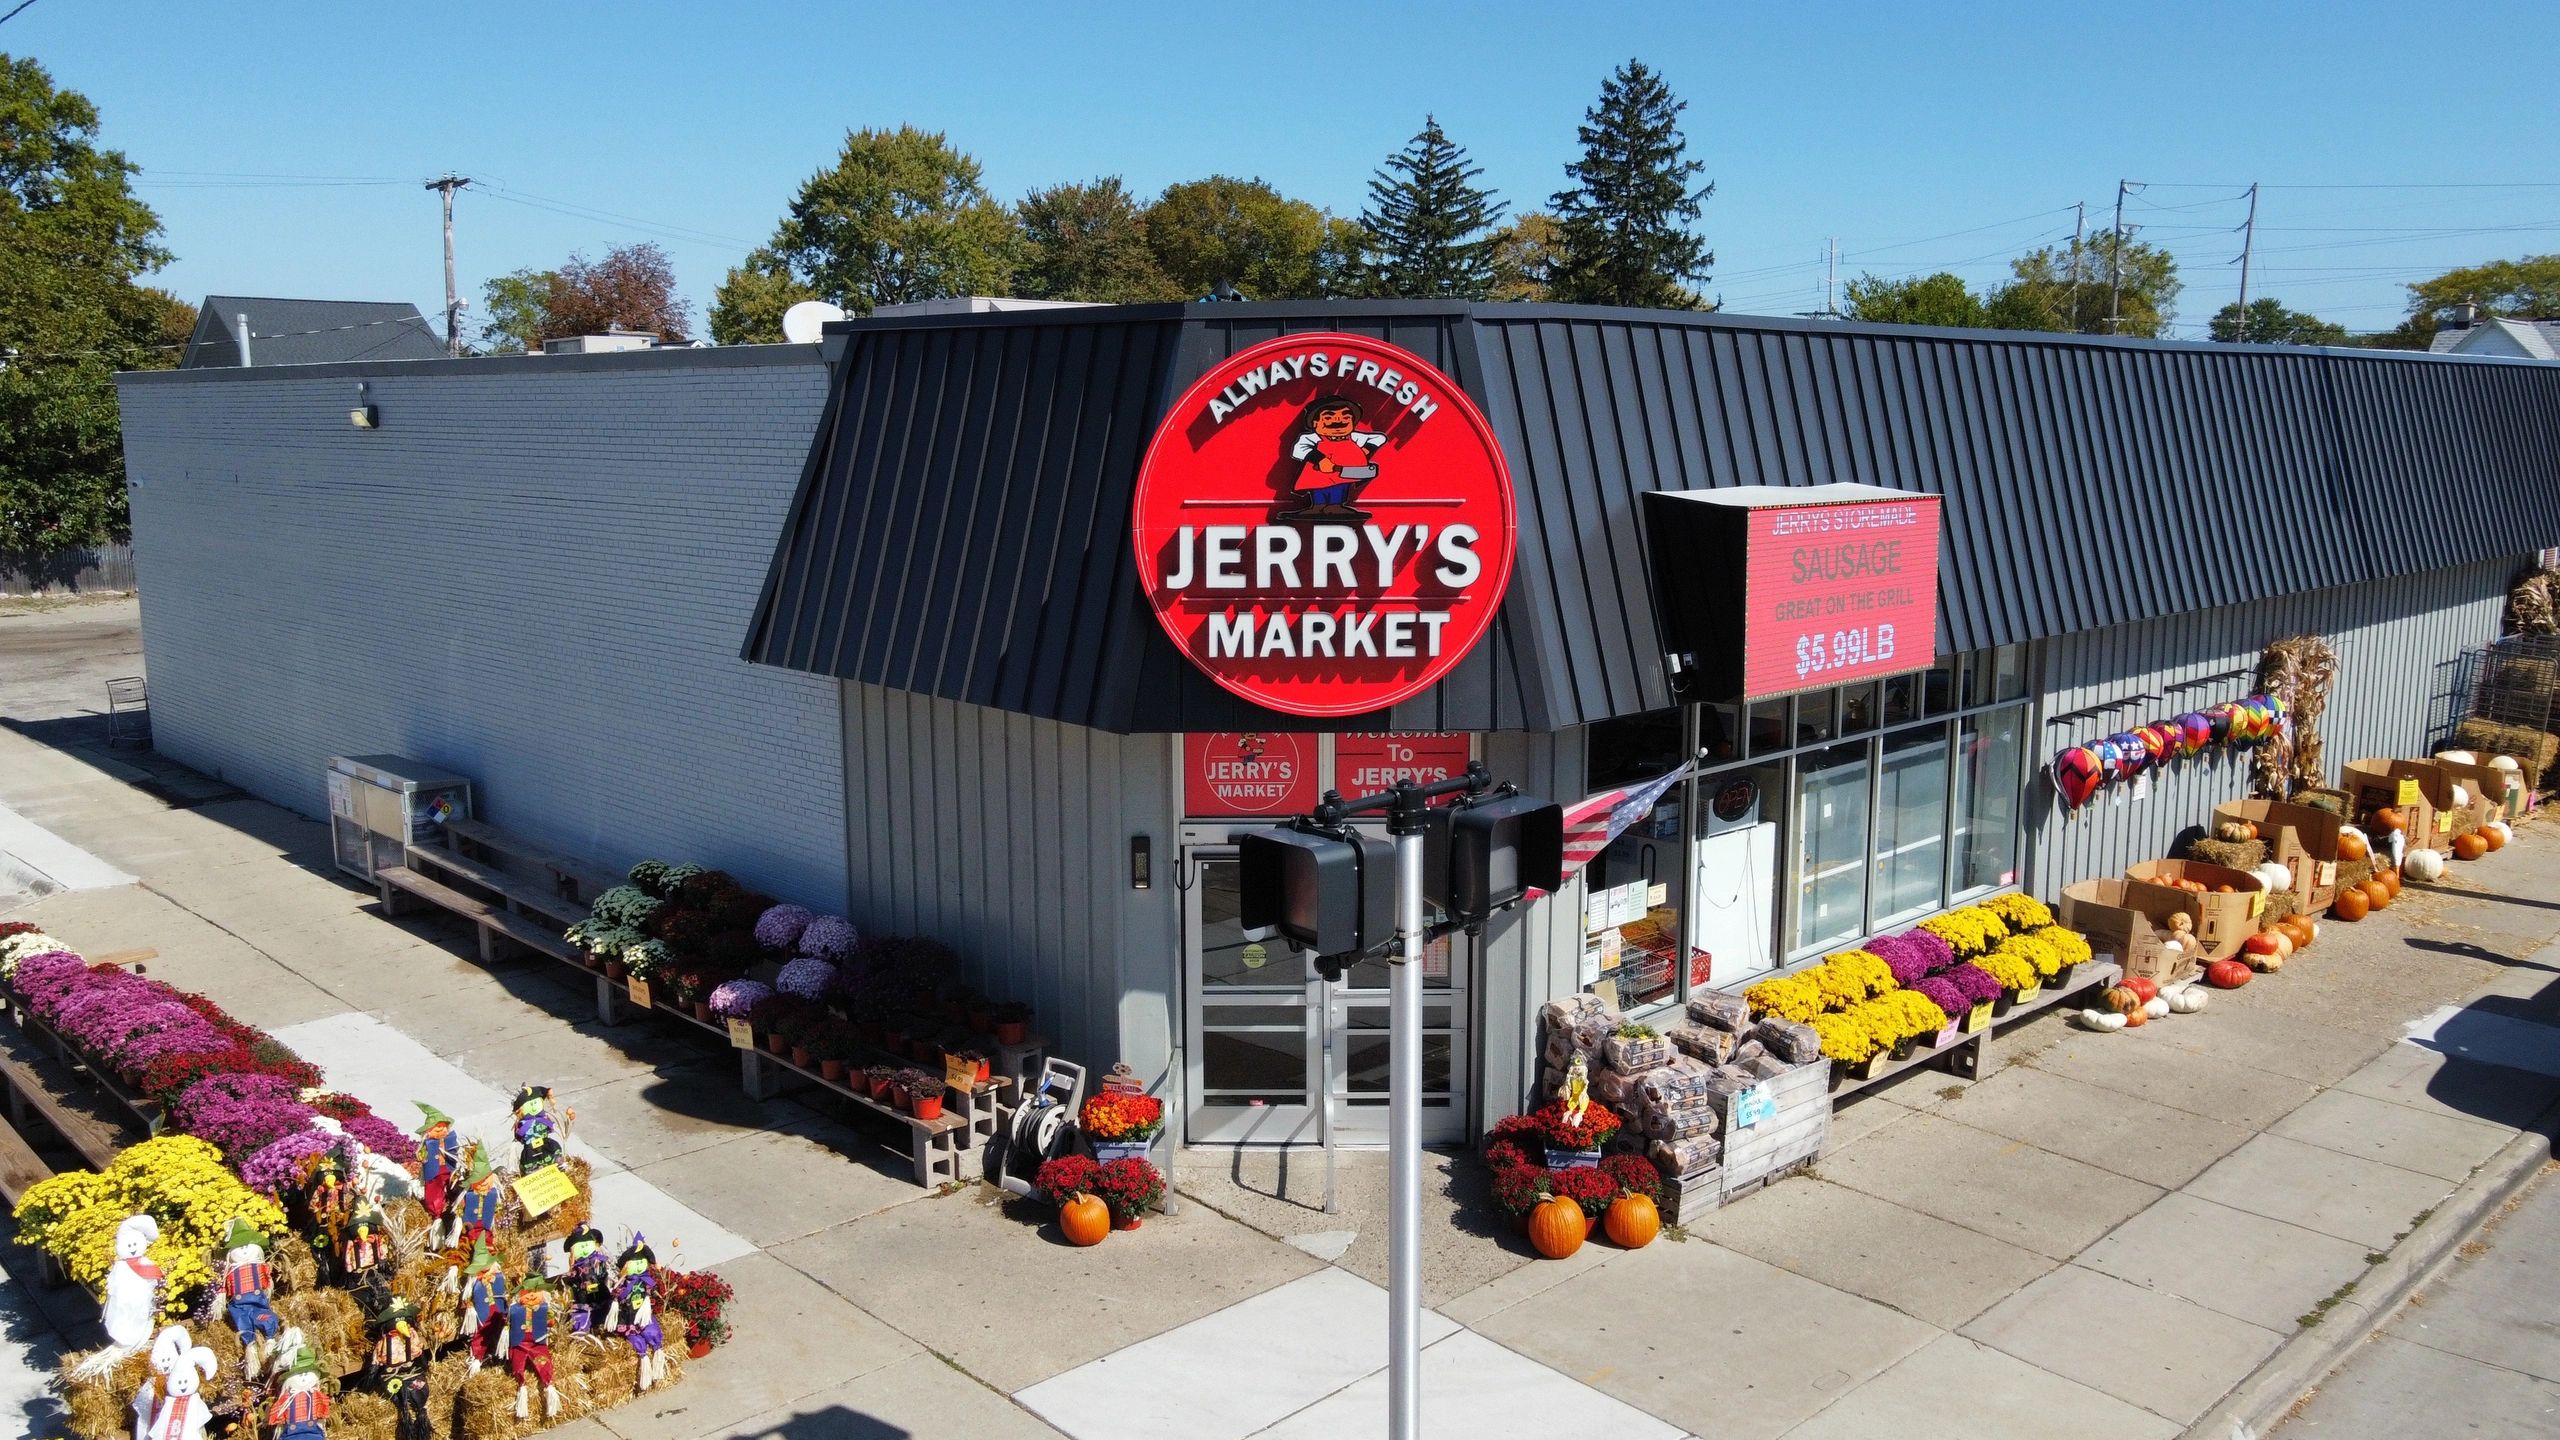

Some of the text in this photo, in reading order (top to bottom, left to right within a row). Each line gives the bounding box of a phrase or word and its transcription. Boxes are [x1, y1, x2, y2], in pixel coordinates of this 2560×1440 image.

[1207, 352, 1440, 424] ALWAYS FRESH
[1166, 523, 1482, 589] JERRY'S
[1792, 540, 1902, 584] SAUSAGE
[1775, 587, 1914, 622] GREAT ON THE GRILL
[1208, 610, 1451, 659] MARKET
[1795, 623, 1895, 680] $5.99LB
[1208, 761, 1292, 780] JERRY'S
[1386, 743, 1415, 762] To
[1218, 784, 1285, 798] MARKET
